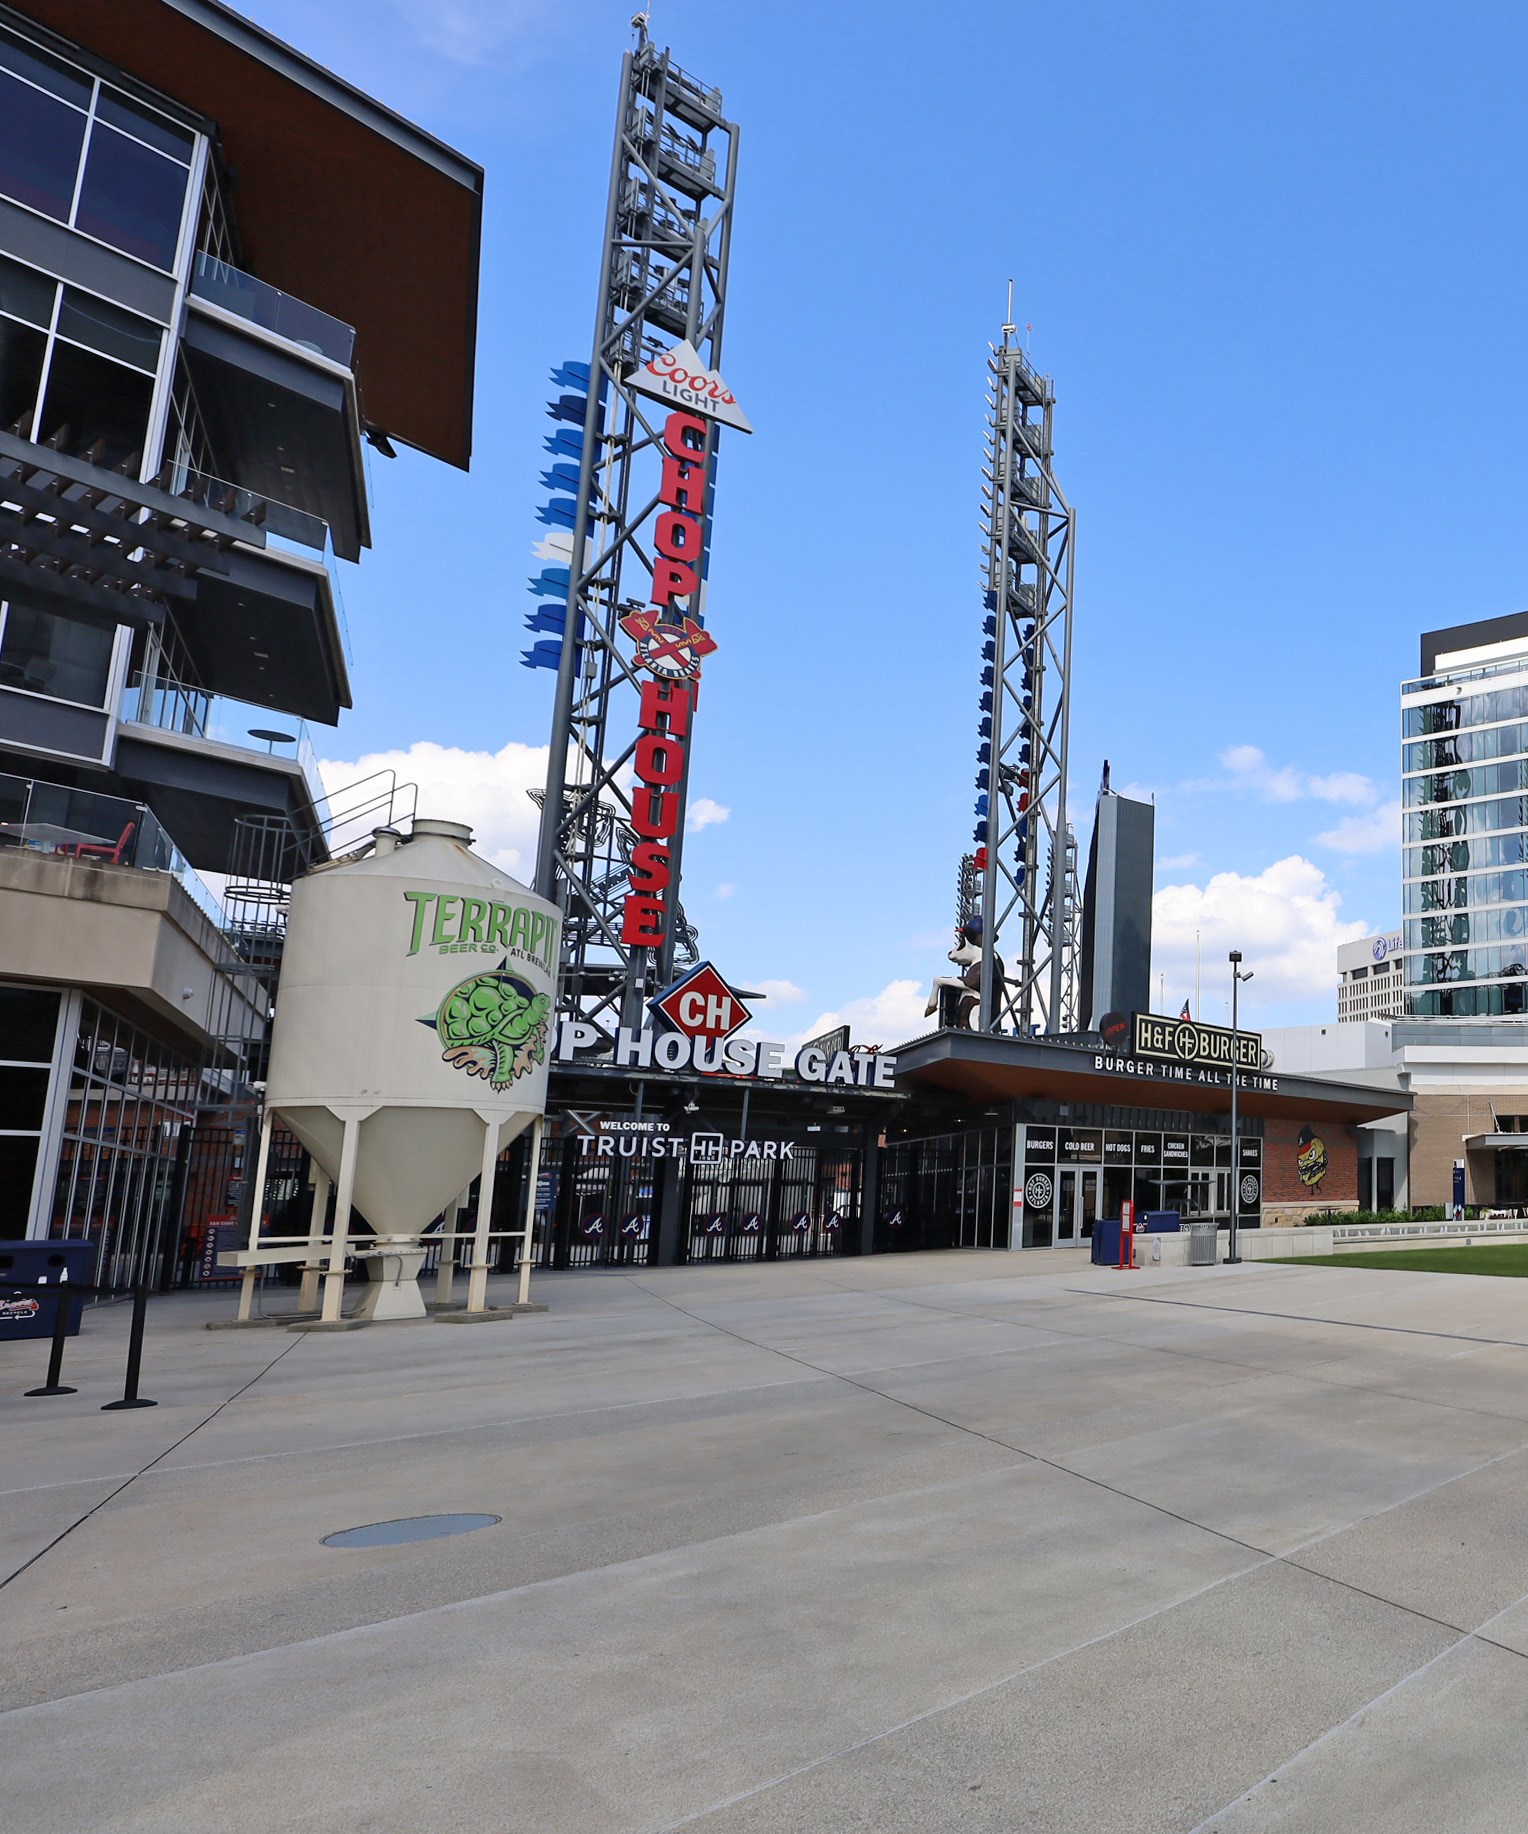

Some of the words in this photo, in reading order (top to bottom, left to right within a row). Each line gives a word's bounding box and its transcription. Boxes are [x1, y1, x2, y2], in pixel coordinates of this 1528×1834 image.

[645, 352, 737, 405] Coors
[662, 379, 720, 412] LIGHT
[650, 410, 708, 607] CHOP
[620, 680, 690, 947] HOUSE
[438, 942, 478, 955] BEER
[510, 947, 525, 960] ATL
[678, 990, 732, 1032] CH
[1141, 1022, 1174, 1051] H&F
[613, 1026, 786, 1079] HOUSE
[796, 1047, 898, 1089] GATE
[1094, 1056, 1154, 1077] BURGER
[1161, 1064, 1192, 1081] TIME
[1198, 1072, 1220, 1084] ALL
[1253, 1077, 1278, 1091] TIME
[600, 1121, 655, 1131] WELCOME
[656, 1123, 671, 1132] TO
[577, 1134, 685, 1158] TRUIST
[730, 1140, 796, 1160] PARK
[1026, 1140, 1054, 1150] BURGERS
[1064, 1141, 1080, 1151] COLD
[1080, 1142, 1095, 1151] BEER
[1105, 1143, 1116, 1152] HOT
[1116, 1144, 1131, 1152] DOGS
[1140, 1144, 1155, 1153] FRIES
